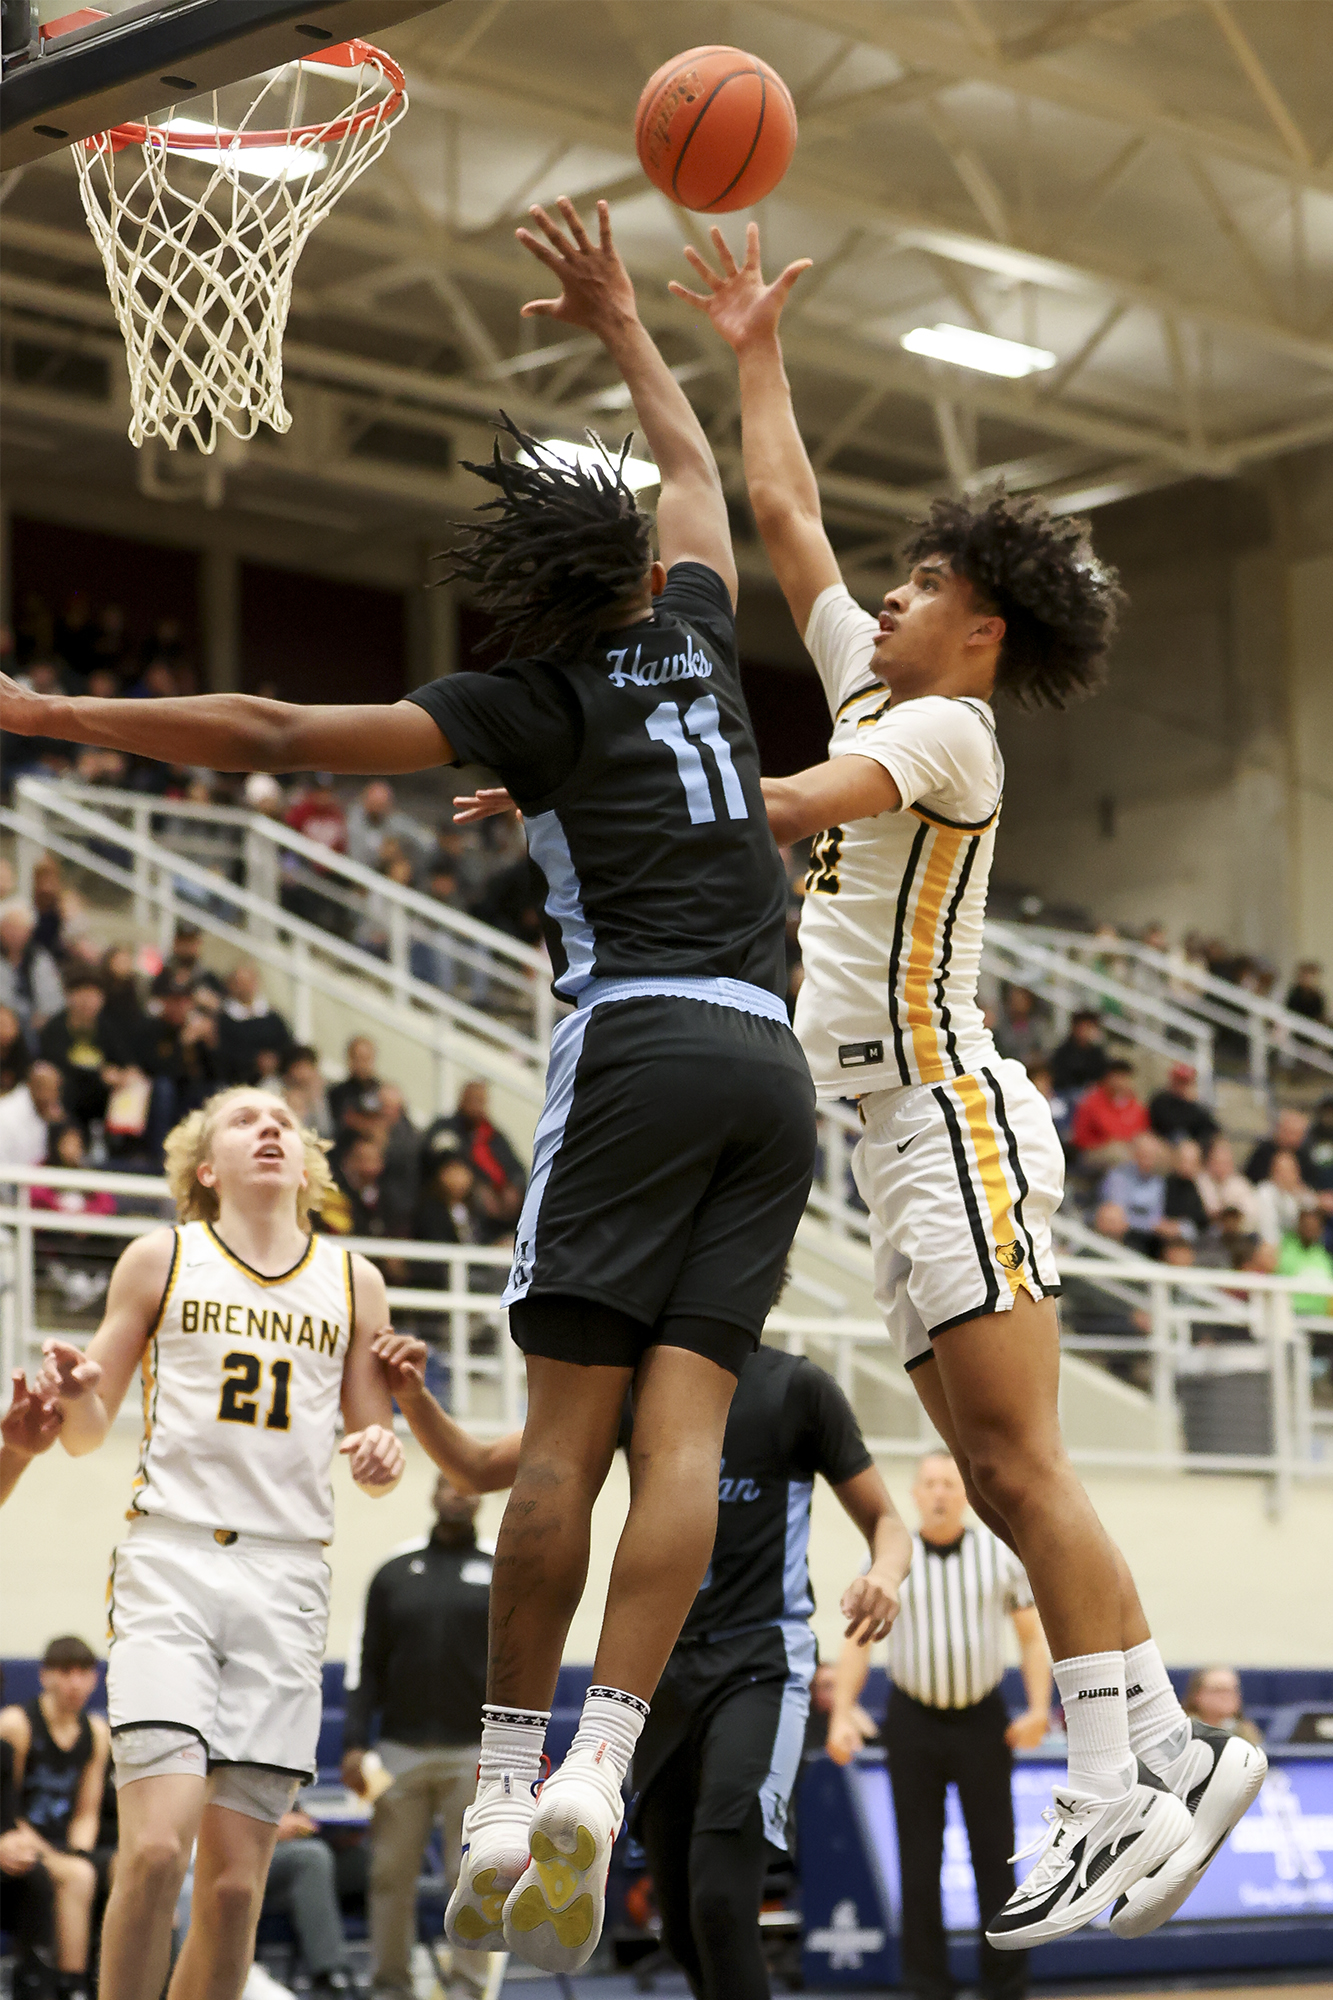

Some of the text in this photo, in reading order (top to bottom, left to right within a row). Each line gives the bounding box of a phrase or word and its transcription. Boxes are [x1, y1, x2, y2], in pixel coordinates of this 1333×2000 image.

[606, 634, 713, 688] Hawks
[645, 694, 749, 825] 11
[182, 1300, 339, 1358] BRENNAN
[217, 1350, 292, 1432] 21
[1078, 1687, 1119, 1700] PUMA
